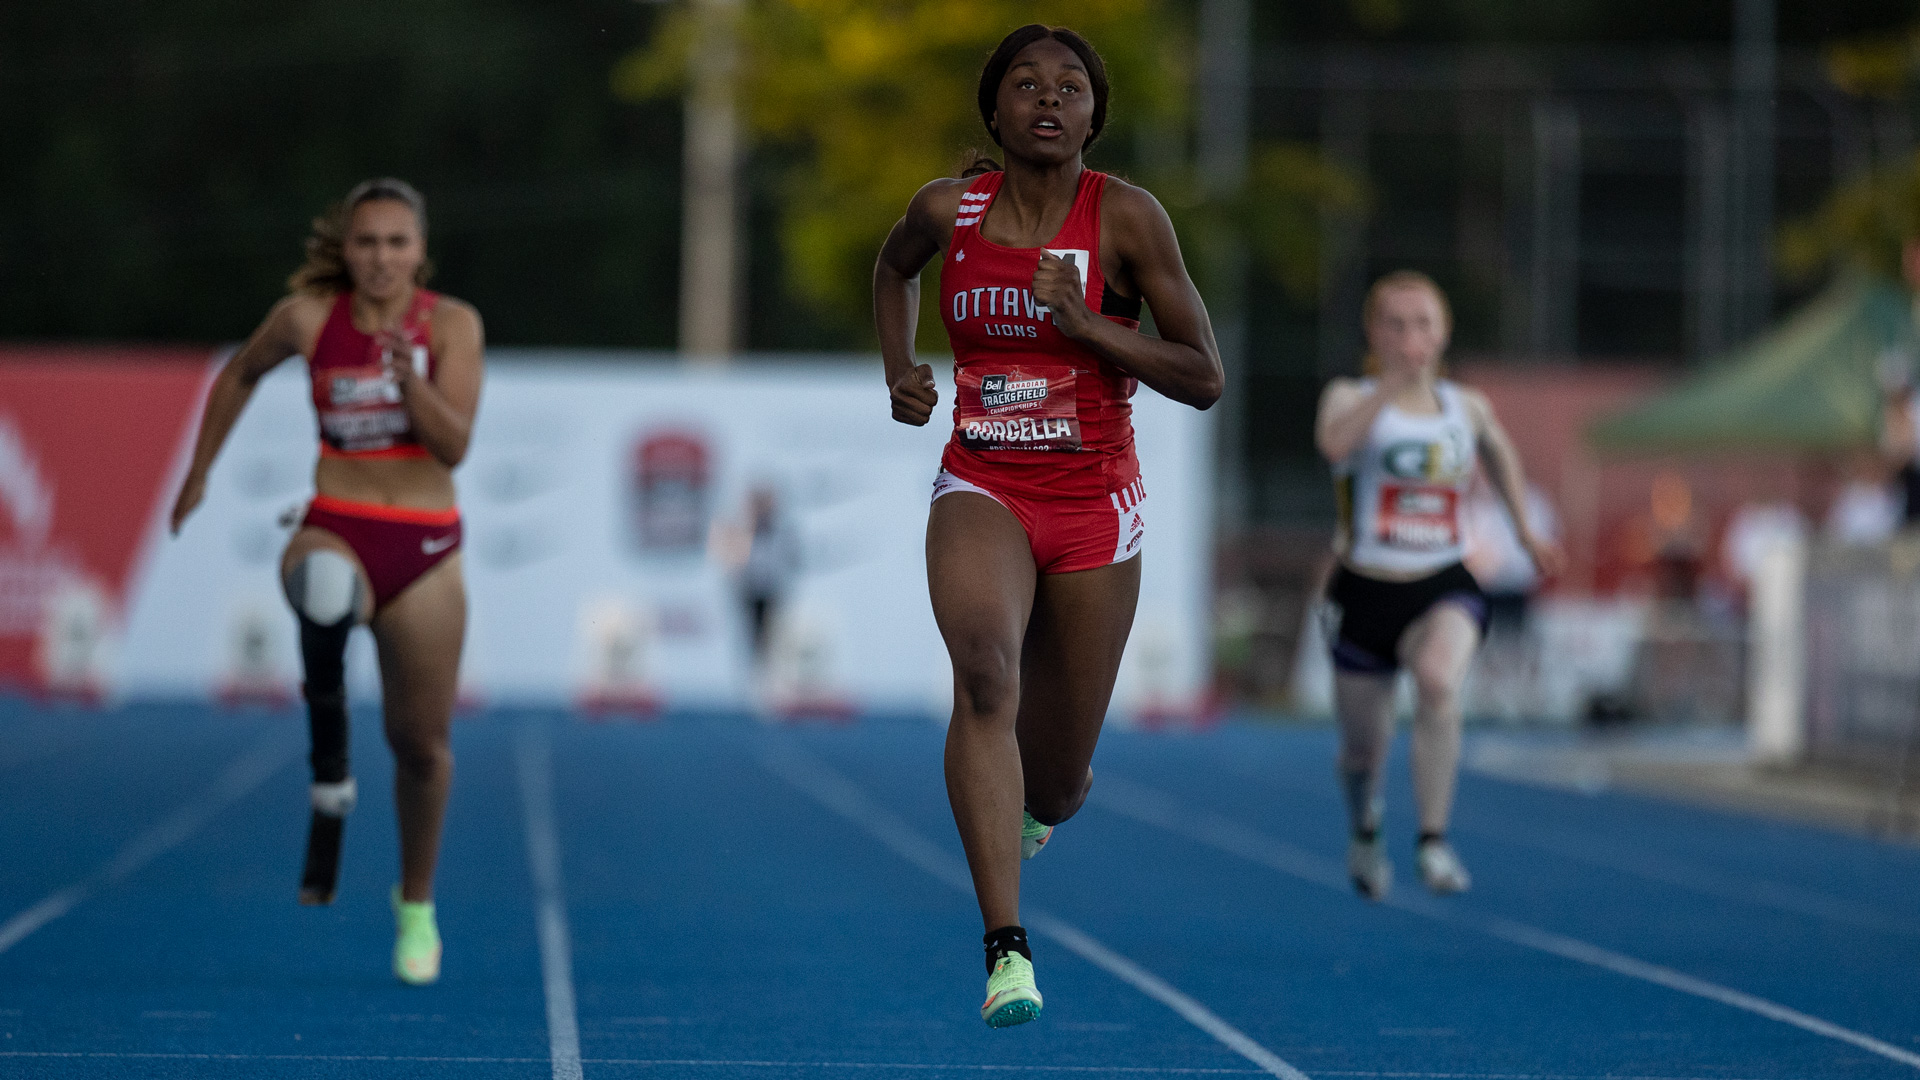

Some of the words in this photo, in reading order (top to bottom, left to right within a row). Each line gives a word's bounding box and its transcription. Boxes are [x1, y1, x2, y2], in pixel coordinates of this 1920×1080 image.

[953, 286, 1056, 325] OTTAW
[984, 323, 1038, 338] LIONS
[985, 380, 1003, 390] Bell
[1006, 380, 1045, 391] CANADIAN
